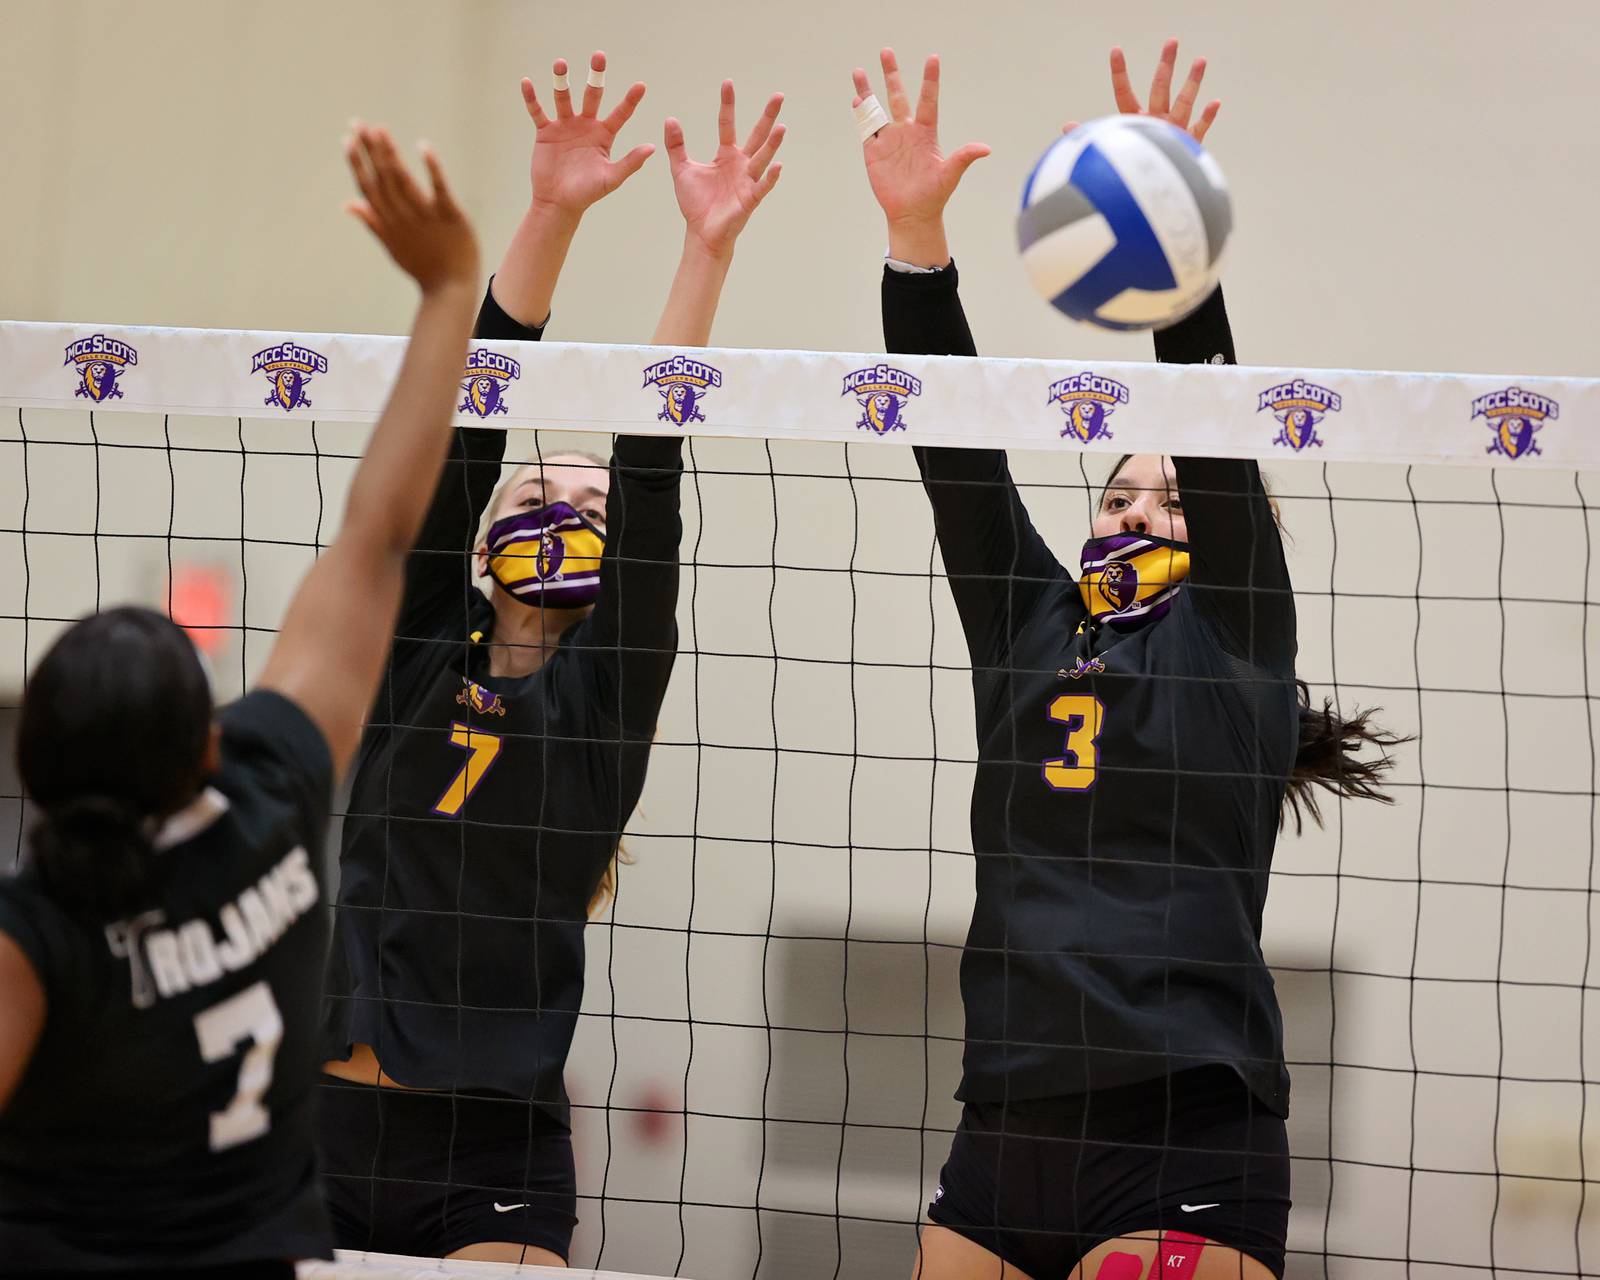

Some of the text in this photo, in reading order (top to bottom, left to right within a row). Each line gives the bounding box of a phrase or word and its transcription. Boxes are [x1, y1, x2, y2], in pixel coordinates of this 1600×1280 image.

[432, 720, 503, 819] 7
[1041, 693, 1106, 792] 3
[104, 845, 319, 1009] TROJANS
[193, 981, 284, 1152] 7
[1167, 1255, 1185, 1267] KT
